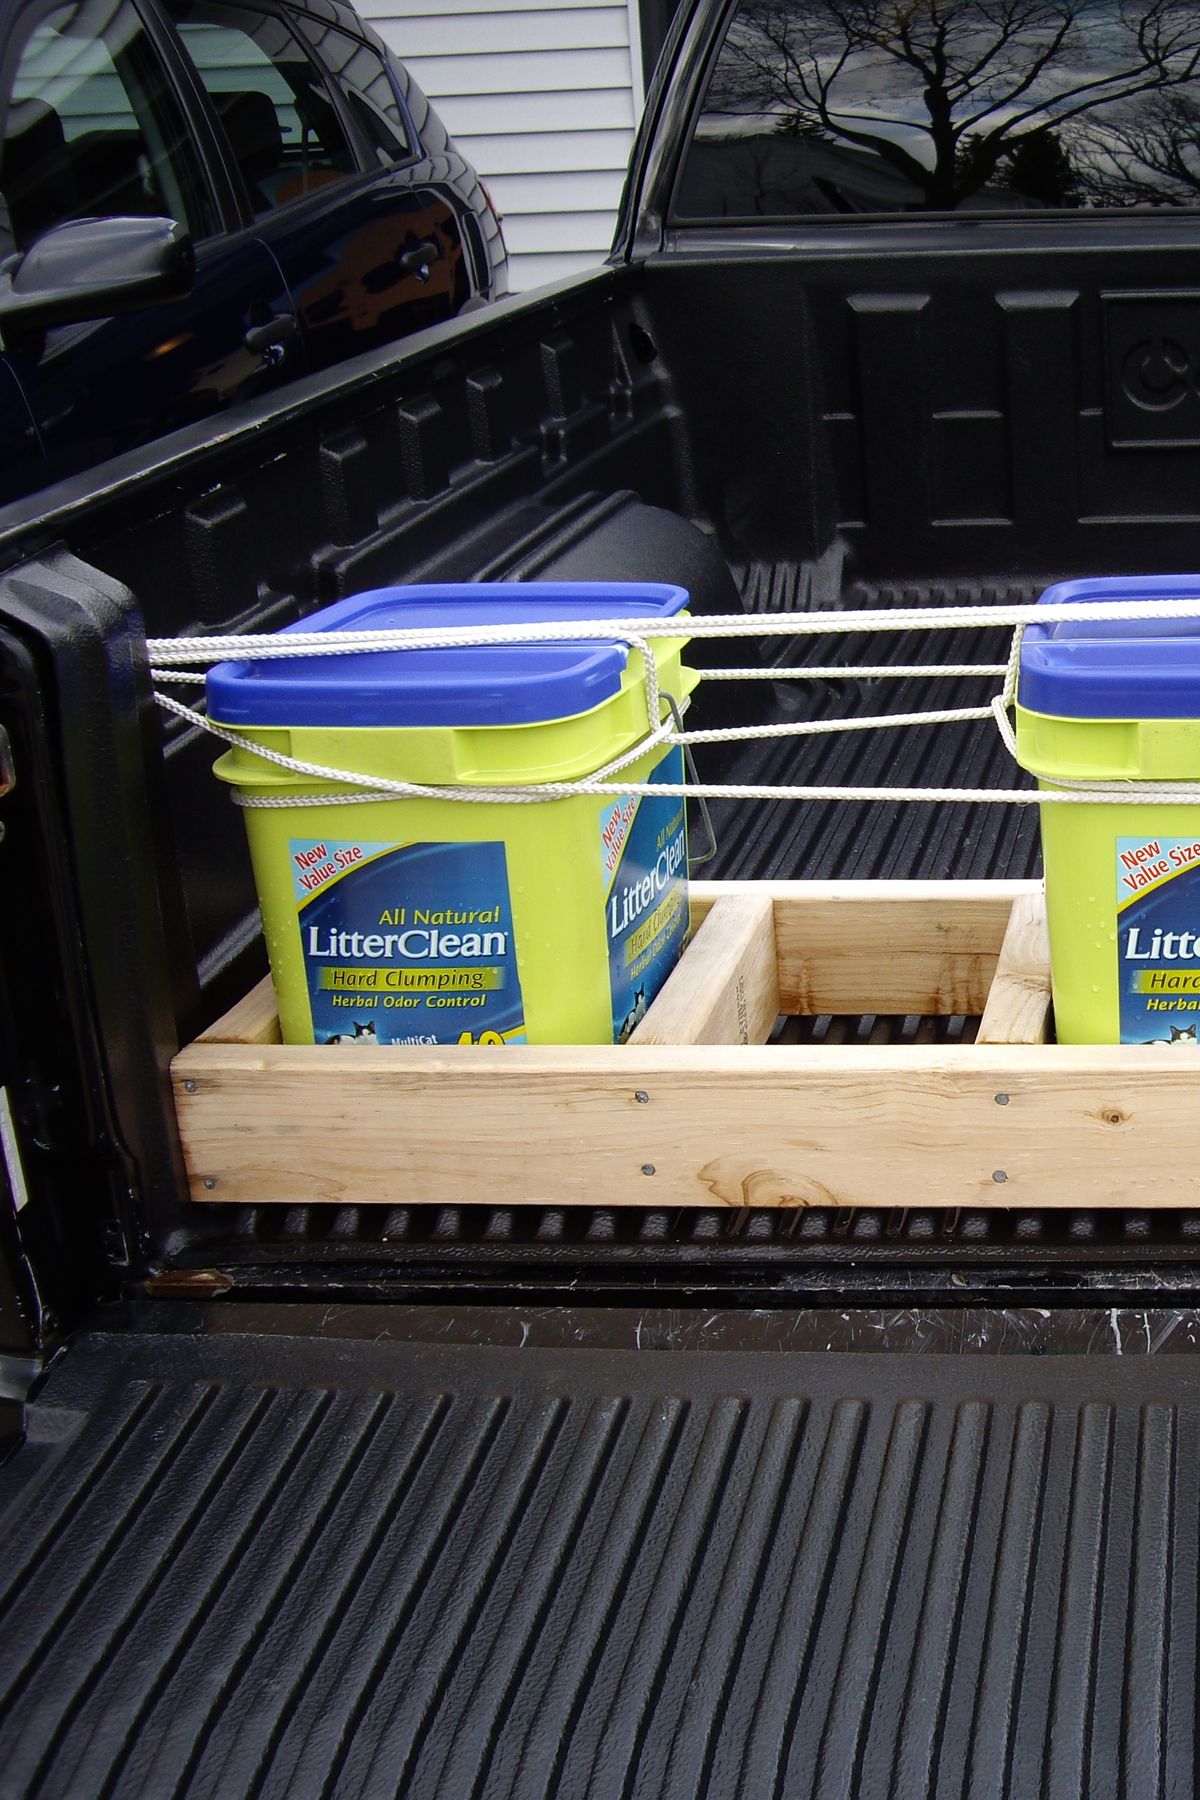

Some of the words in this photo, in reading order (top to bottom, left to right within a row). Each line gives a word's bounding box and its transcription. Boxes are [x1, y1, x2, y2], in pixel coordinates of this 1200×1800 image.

[602, 804, 622, 849] New
[605, 828, 626, 872] Value
[622, 796, 637, 830] Size
[294, 843, 328, 870] New
[298, 863, 337, 891] Value
[334, 845, 363, 869] Size
[1120, 841, 1160, 871] New
[610, 826, 686, 939] LitterClean
[1122, 860, 1170, 890] Value
[378, 906, 405, 926] All
[413, 905, 501, 925] Natural
[308, 926, 508, 959] LitterClean
[333, 969, 379, 988] Hard
[385, 969, 485, 990] Clumping
[332, 994, 379, 1008] Herbal
[382, 995, 421, 1009] Odor
[426, 993, 487, 1008] Control
